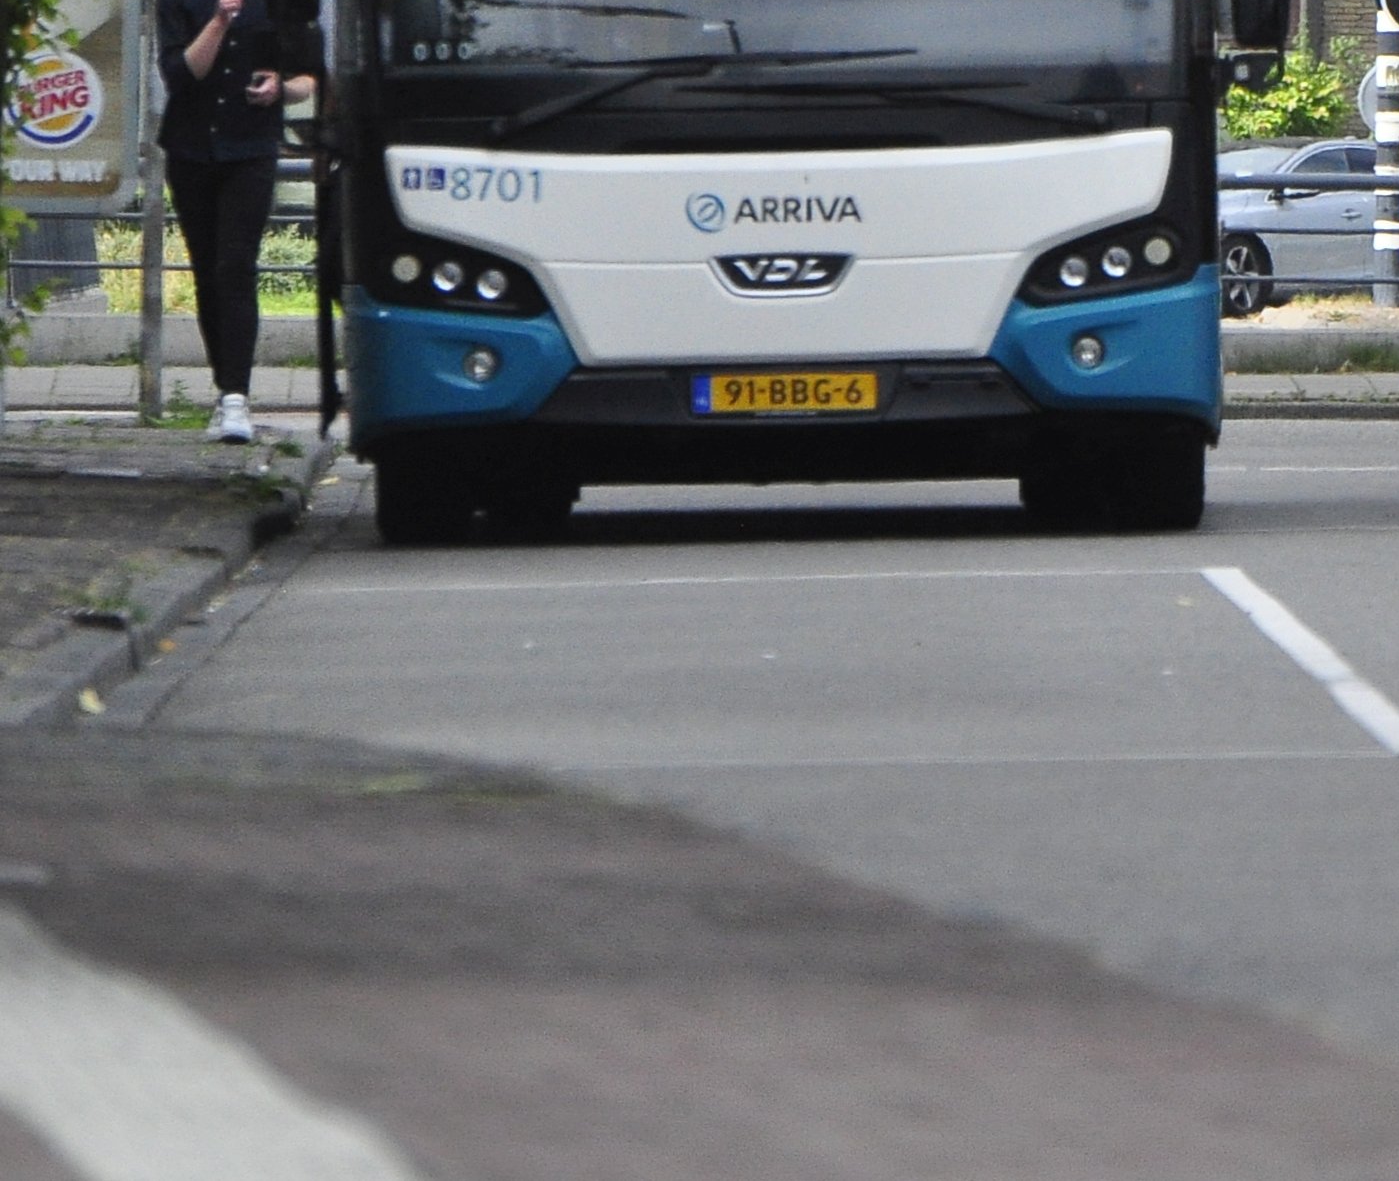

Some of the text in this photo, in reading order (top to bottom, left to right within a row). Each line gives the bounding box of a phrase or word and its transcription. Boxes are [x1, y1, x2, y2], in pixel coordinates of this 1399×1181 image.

[451, 167, 542, 203] 8701
[734, 196, 862, 224] ARRIVA
[724, 378, 863, 406] 91-BBG-6
